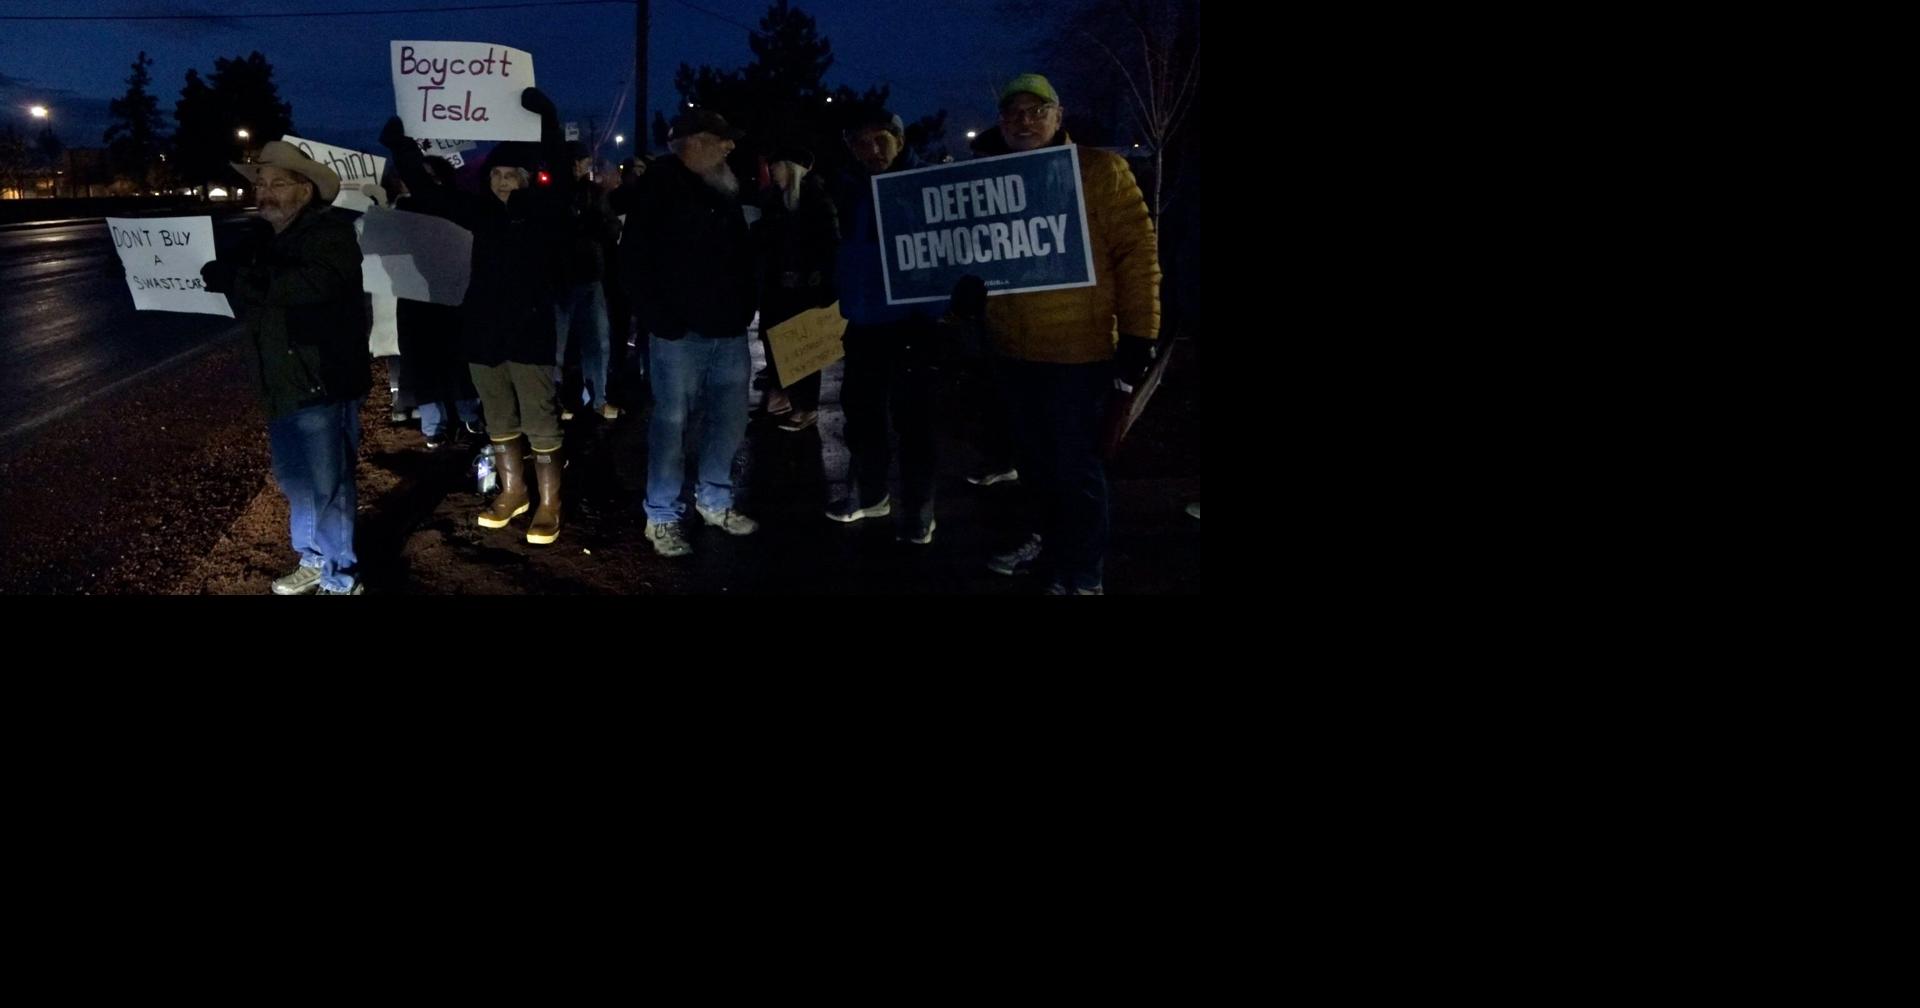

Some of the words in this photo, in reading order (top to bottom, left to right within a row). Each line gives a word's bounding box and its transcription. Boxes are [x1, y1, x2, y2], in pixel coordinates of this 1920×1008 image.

[401, 46, 512, 85] Boycott
[418, 86, 489, 122] Tesla
[921, 174, 1027, 224] DEFEND
[112, 226, 152, 248] DON'T
[159, 230, 190, 246] BUY
[895, 214, 1068, 271] DEMOCRACY
[154, 255, 162, 265] A
